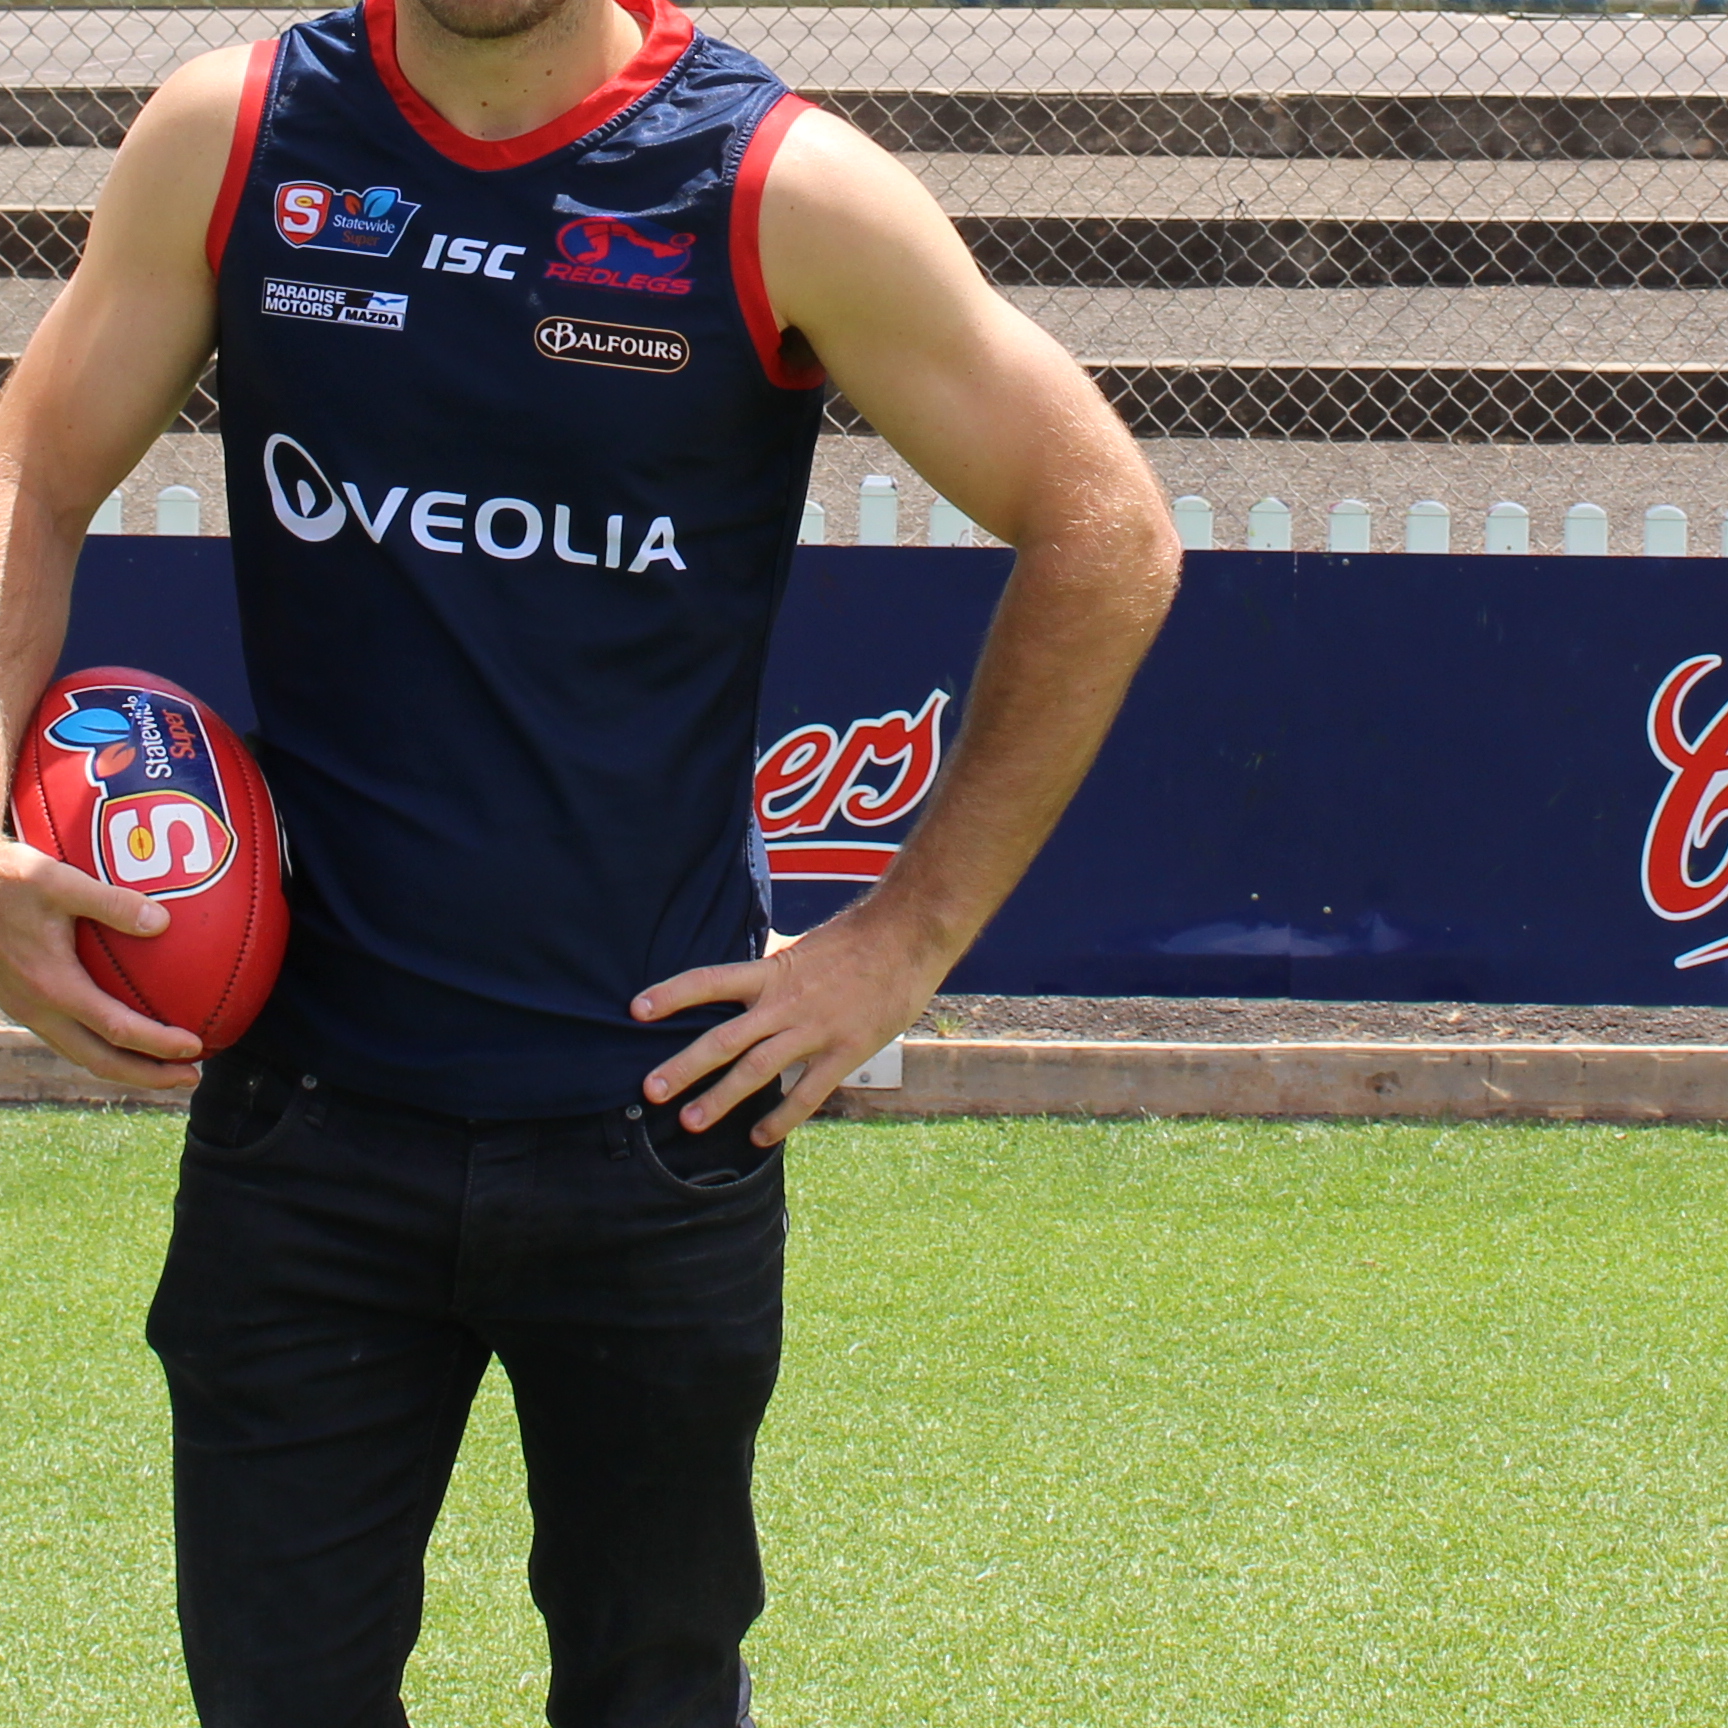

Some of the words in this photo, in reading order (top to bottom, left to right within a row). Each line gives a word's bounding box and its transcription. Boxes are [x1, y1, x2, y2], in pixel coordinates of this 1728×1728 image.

[332, 214, 396, 234] Statewide
[342, 230, 381, 247] Super
[421, 233, 526, 281] ISC
[266, 282, 347, 305] PARADISE
[543, 261, 695, 295] REDLEGS
[265, 297, 334, 318] MOTORS
[344, 308, 399, 327] MAZDA
[540, 322, 683, 361] BALFOURS
[342, 480, 687, 573] VEOLIA
[122, 694, 172, 779] Statewide
[161, 708, 197, 760] Super
